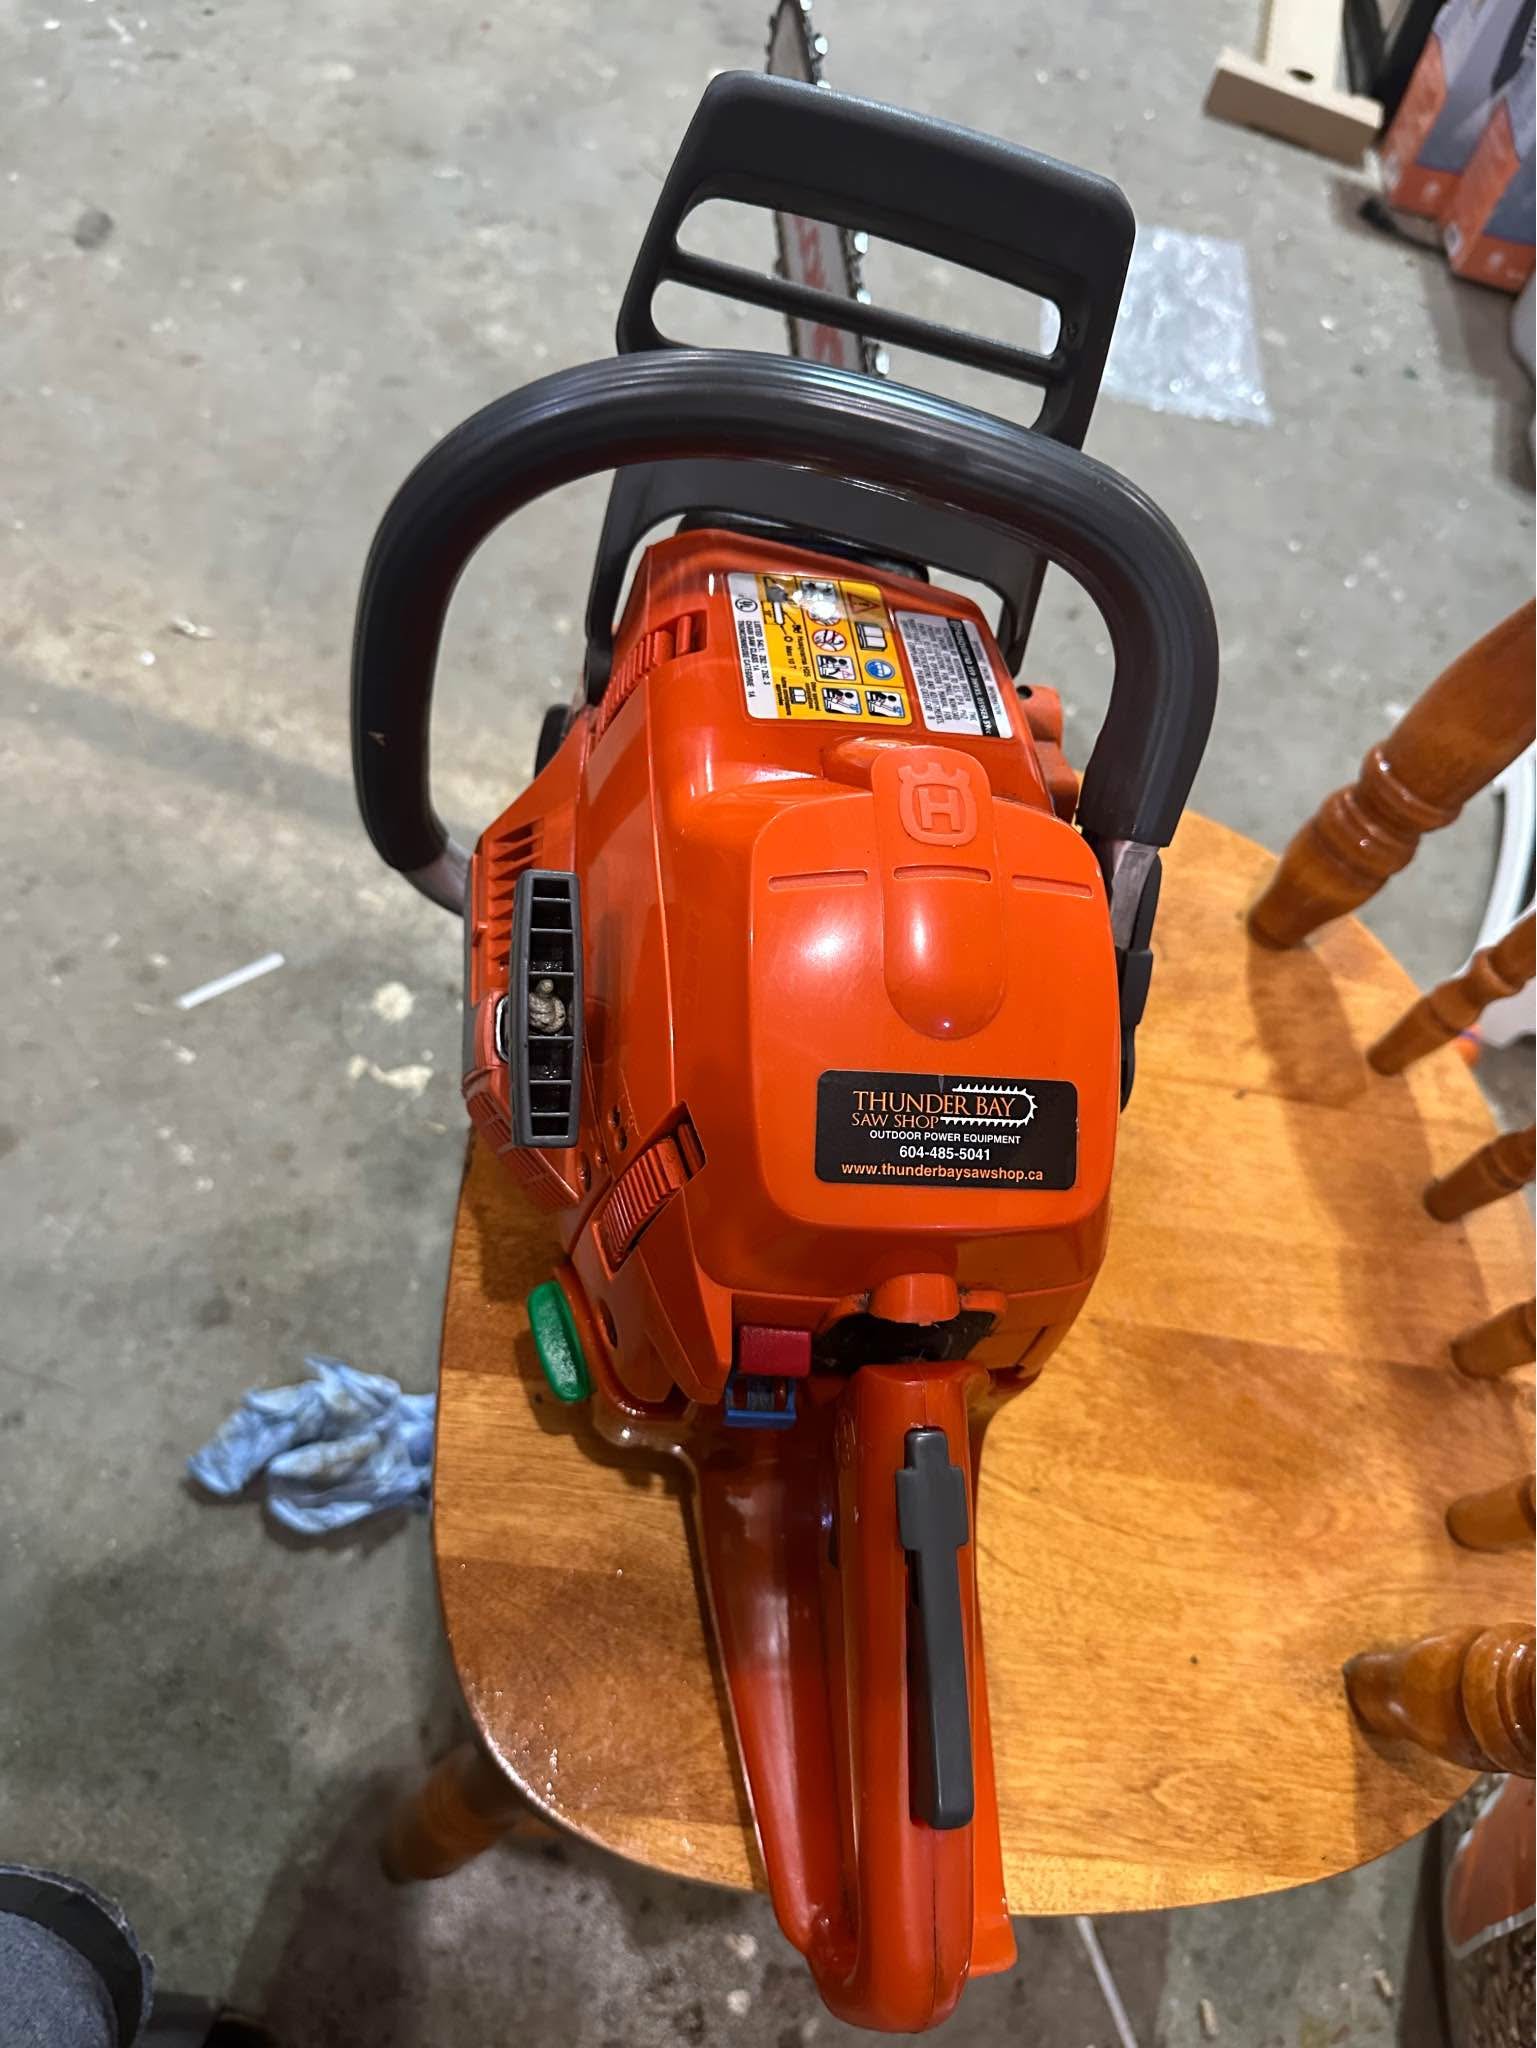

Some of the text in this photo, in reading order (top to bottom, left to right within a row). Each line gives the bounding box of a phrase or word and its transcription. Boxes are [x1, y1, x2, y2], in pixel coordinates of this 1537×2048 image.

[749, 647, 758, 662] CLASS
[852, 1090, 1016, 1117] THUNDER BAY
[851, 1112, 939, 1129] SAW SHOP
[869, 1129, 1021, 1145] OUTDOOR POWER EQUIPMENT
[899, 1145, 990, 1161] 604-485-5041
[841, 1162, 1043, 1182] www.thunderbaysawshop.ca
